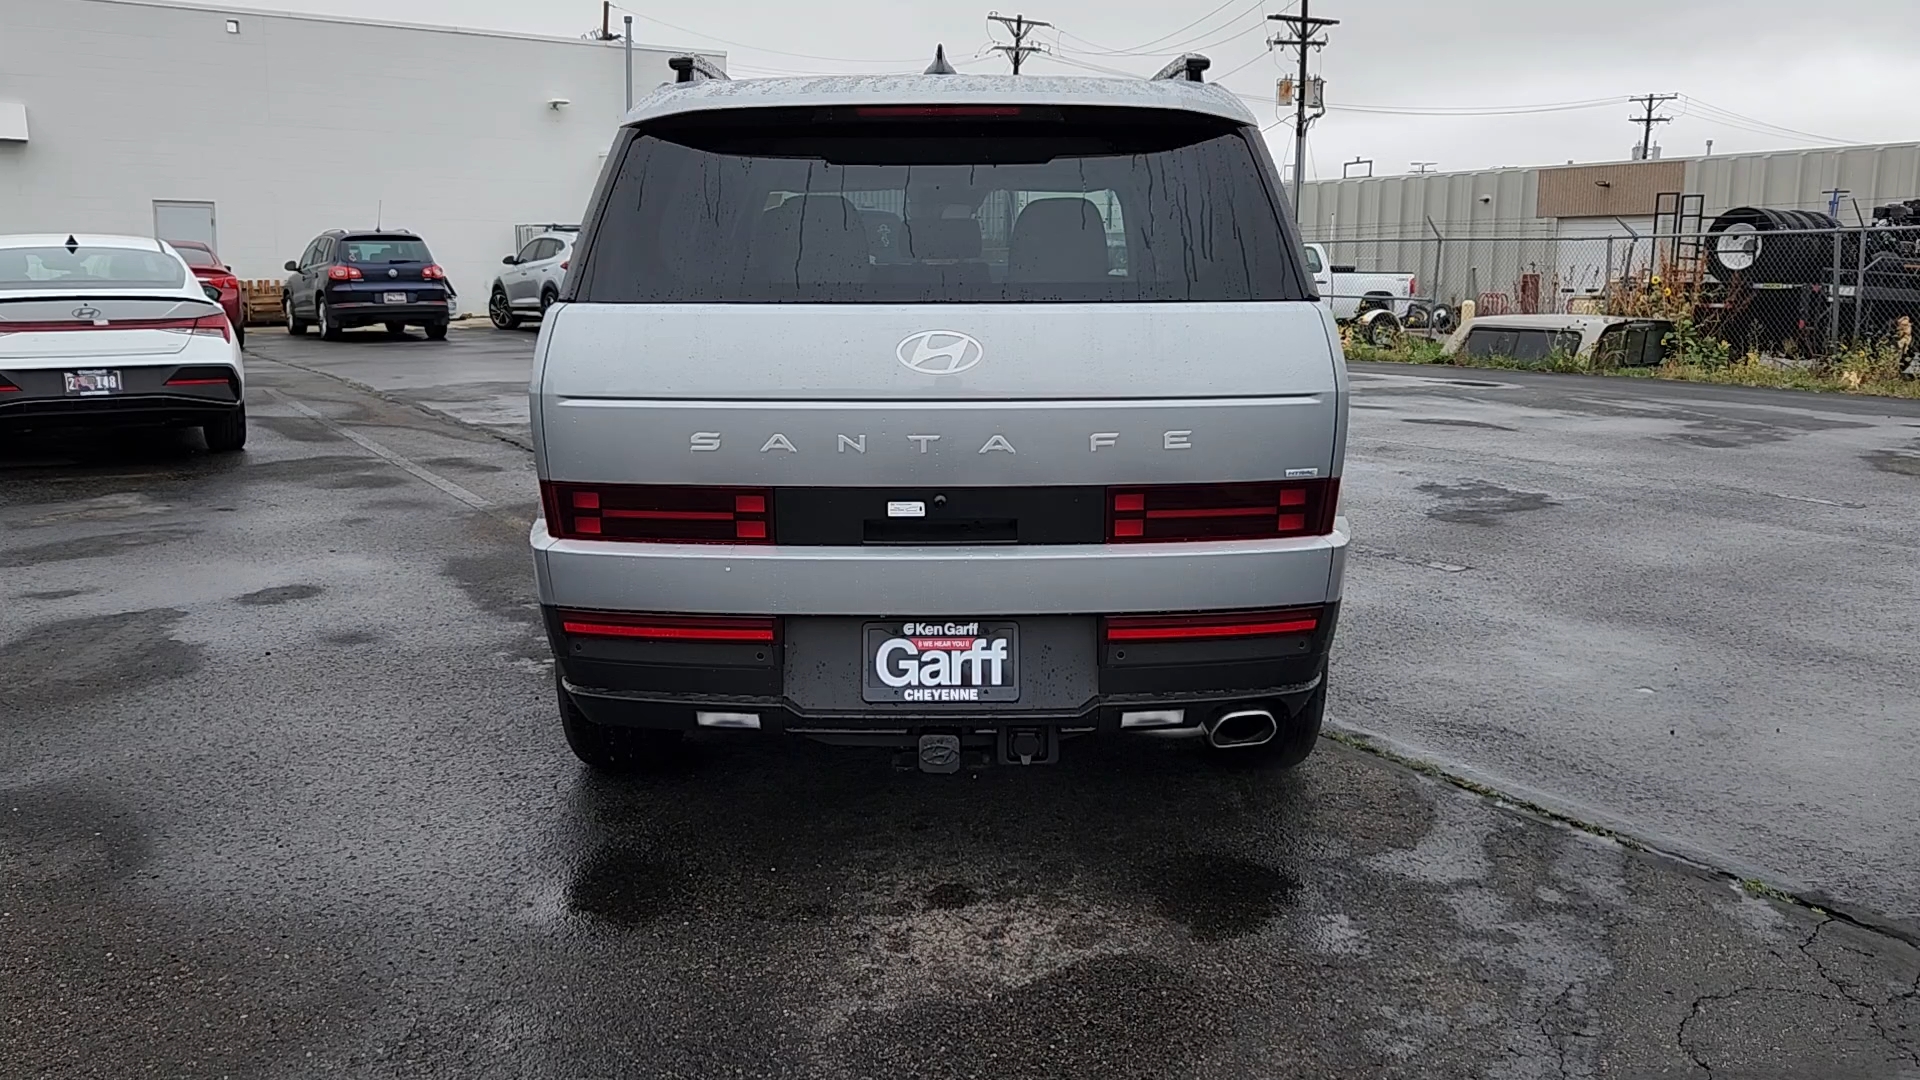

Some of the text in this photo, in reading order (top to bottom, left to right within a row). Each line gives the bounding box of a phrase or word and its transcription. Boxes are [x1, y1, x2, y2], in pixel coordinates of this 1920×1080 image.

[690, 430, 1192, 454] SANTA FE
[916, 622, 979, 636] Ken Garff
[923, 640, 965, 648] WE HEAR YOU
[876, 638, 1007, 687] Garff
[904, 689, 979, 701] CHEYENNE
